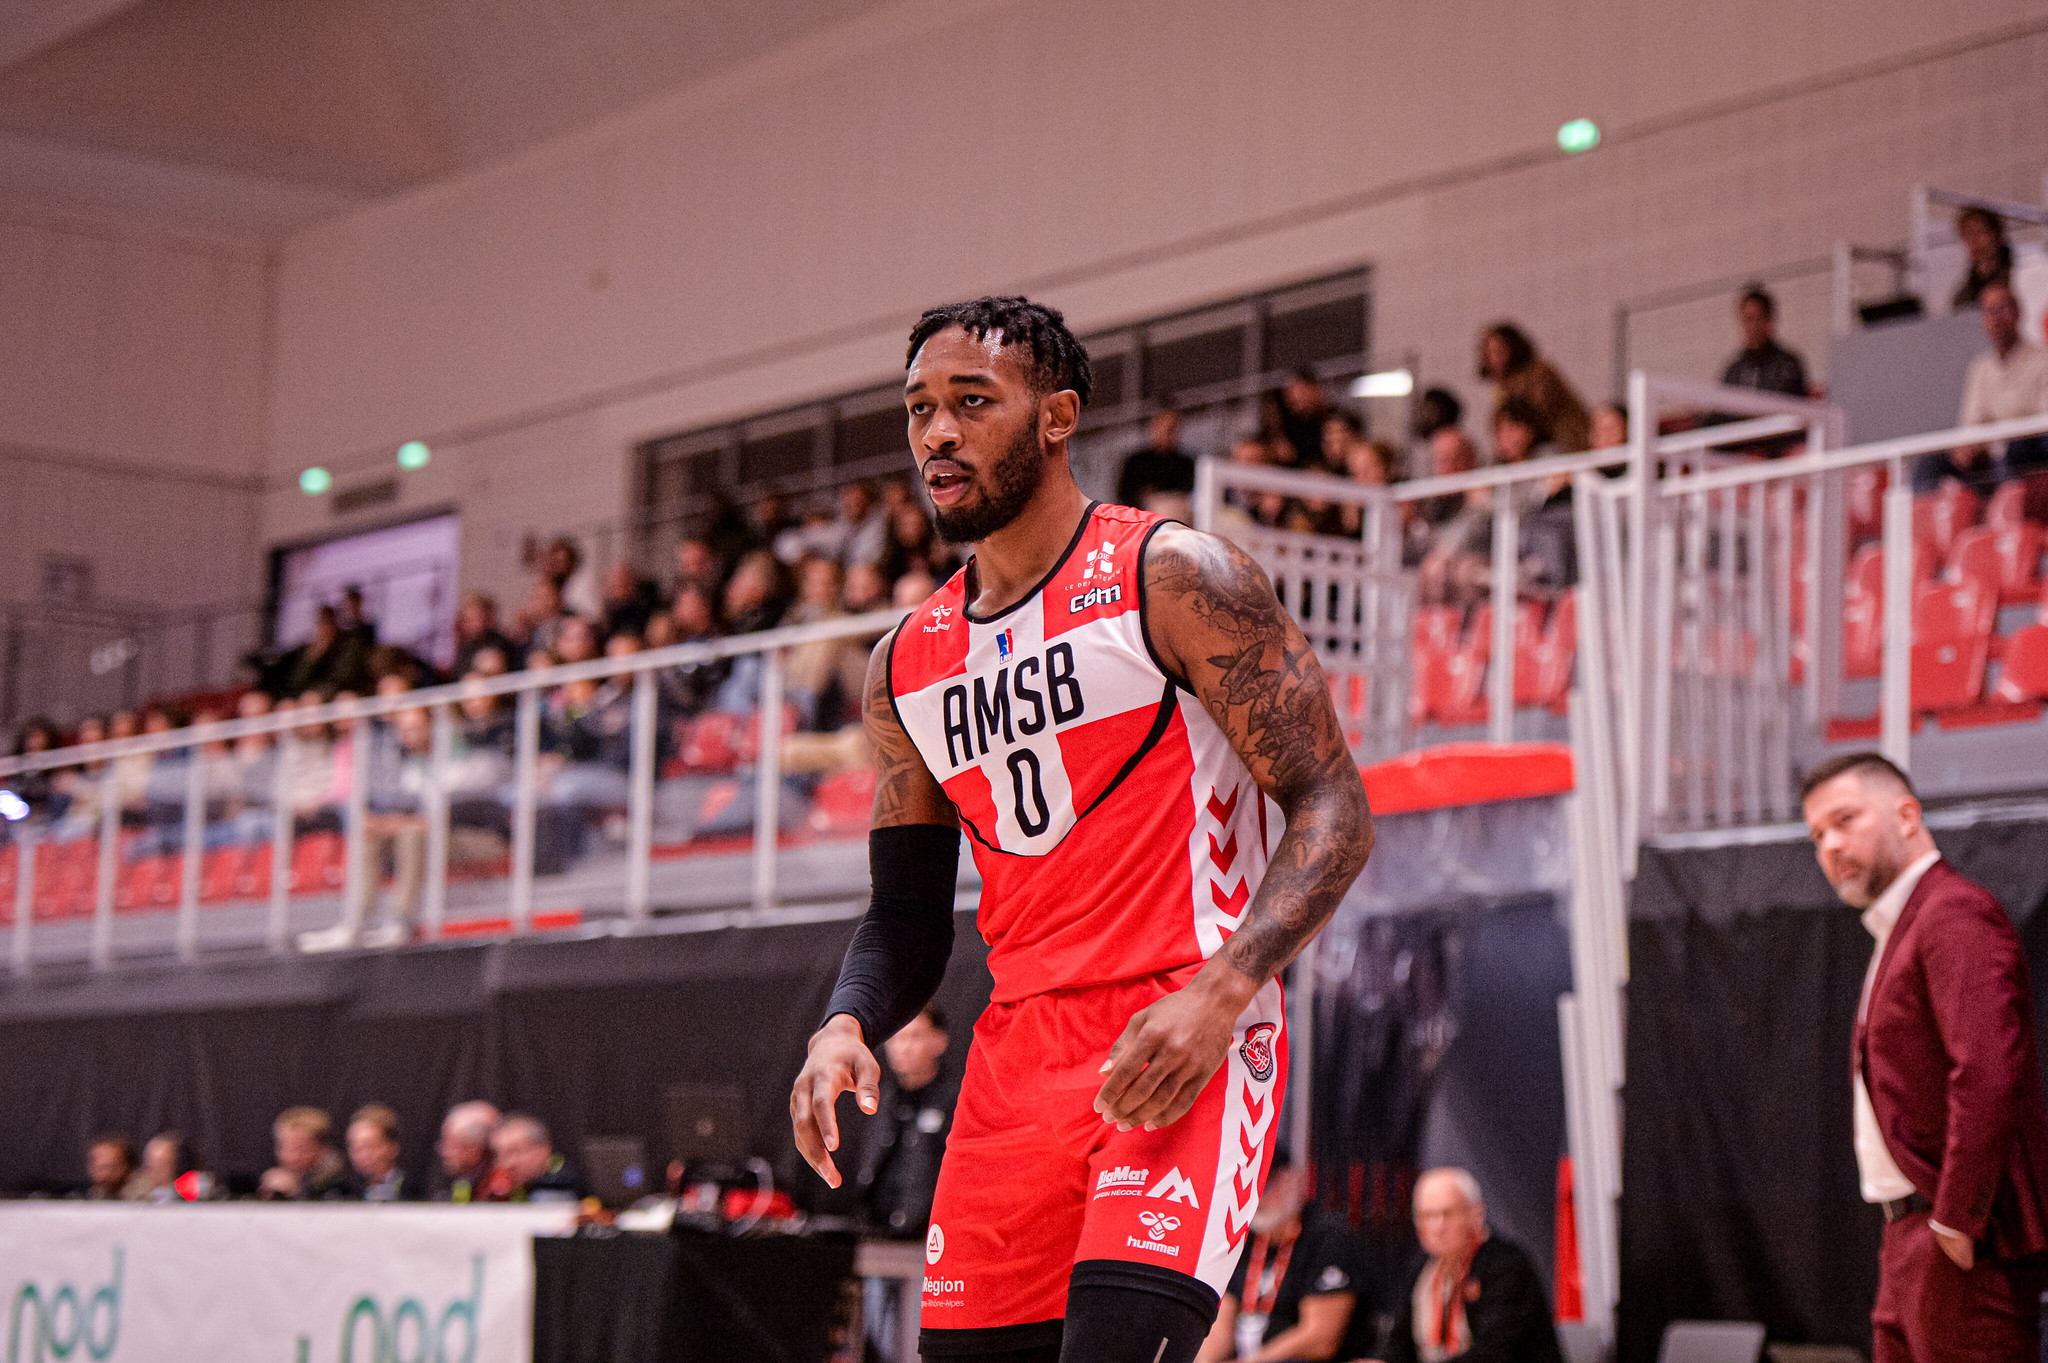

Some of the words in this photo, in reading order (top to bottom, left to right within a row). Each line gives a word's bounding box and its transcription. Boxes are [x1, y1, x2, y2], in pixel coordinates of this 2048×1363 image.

[943, 642, 1085, 768] AMSB
[1006, 748, 1051, 838] 0
[1110, 1188, 1143, 1196] NÉGOCE
[1126, 1235, 1180, 1257] hummel
[922, 1276, 965, 1296] Région
